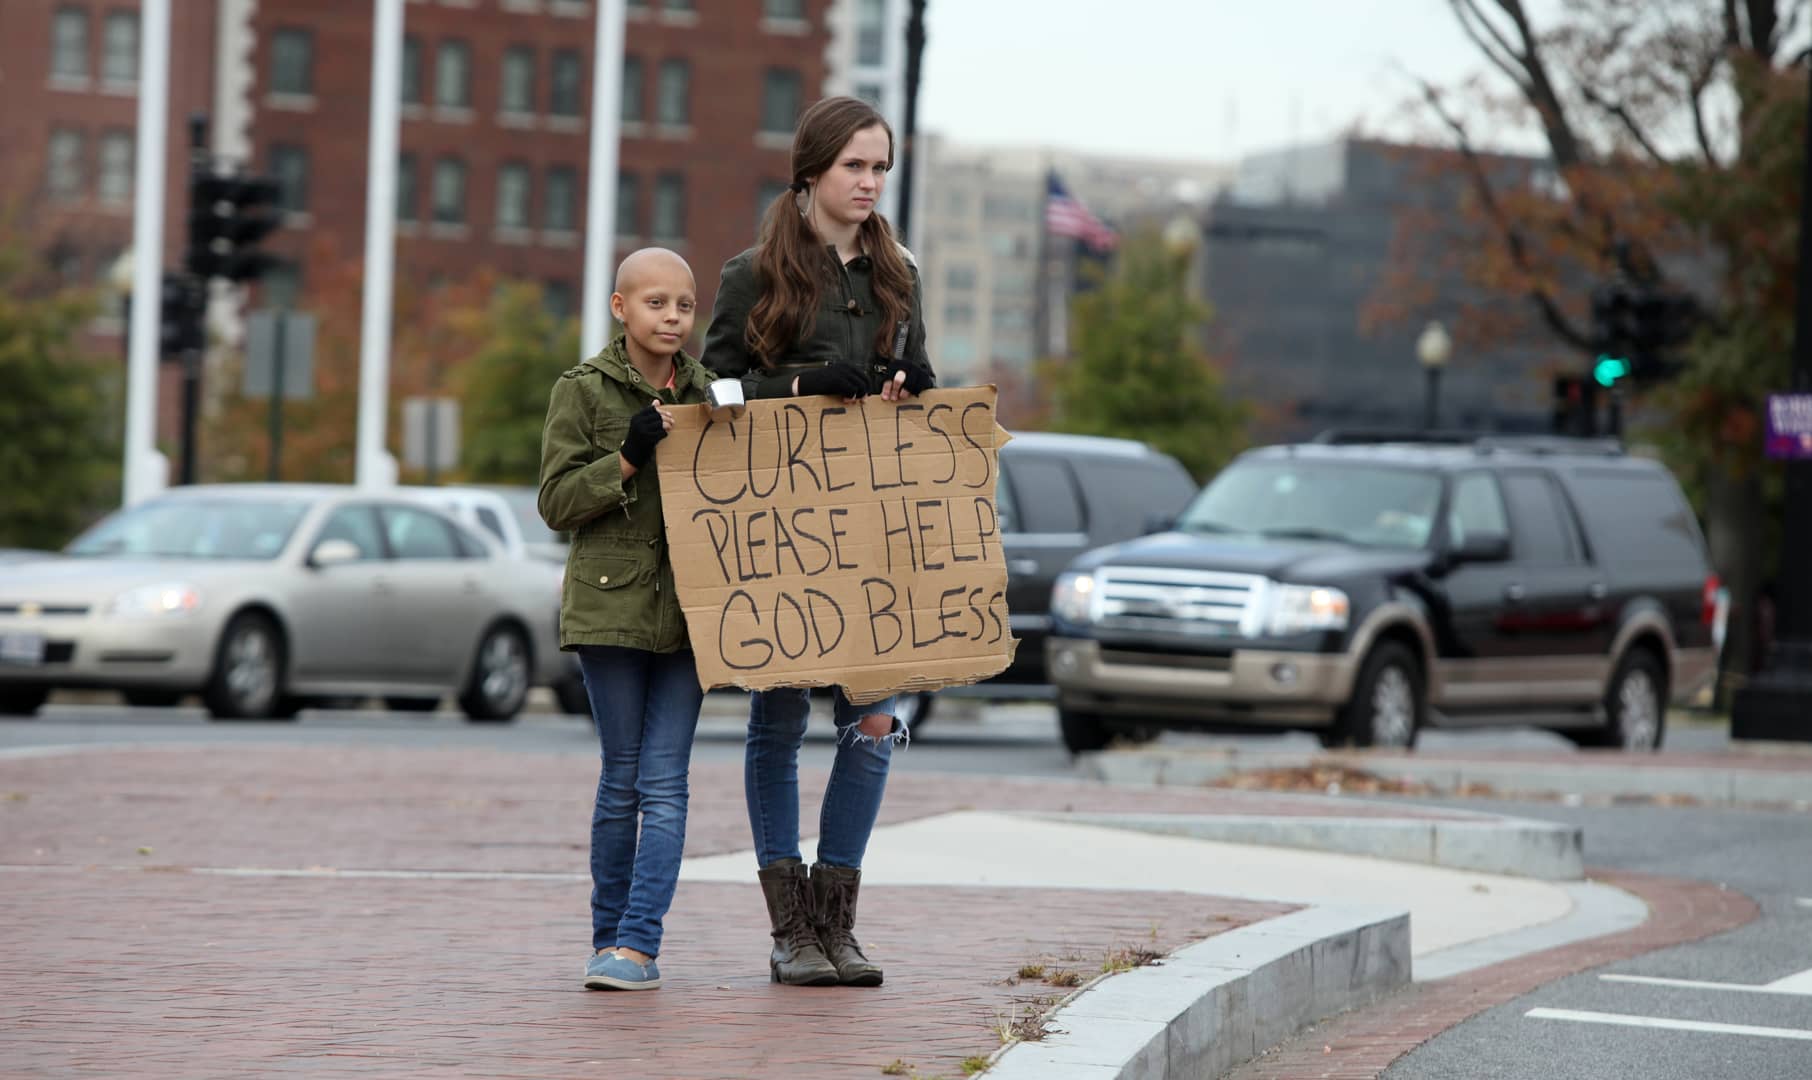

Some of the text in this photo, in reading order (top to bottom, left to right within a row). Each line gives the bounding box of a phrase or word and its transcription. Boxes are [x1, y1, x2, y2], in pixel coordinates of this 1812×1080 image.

[693, 402, 990, 505] CURELESS
[692, 496, 996, 585] PLEASE HELP
[719, 577, 1004, 670] GOD BLESS
